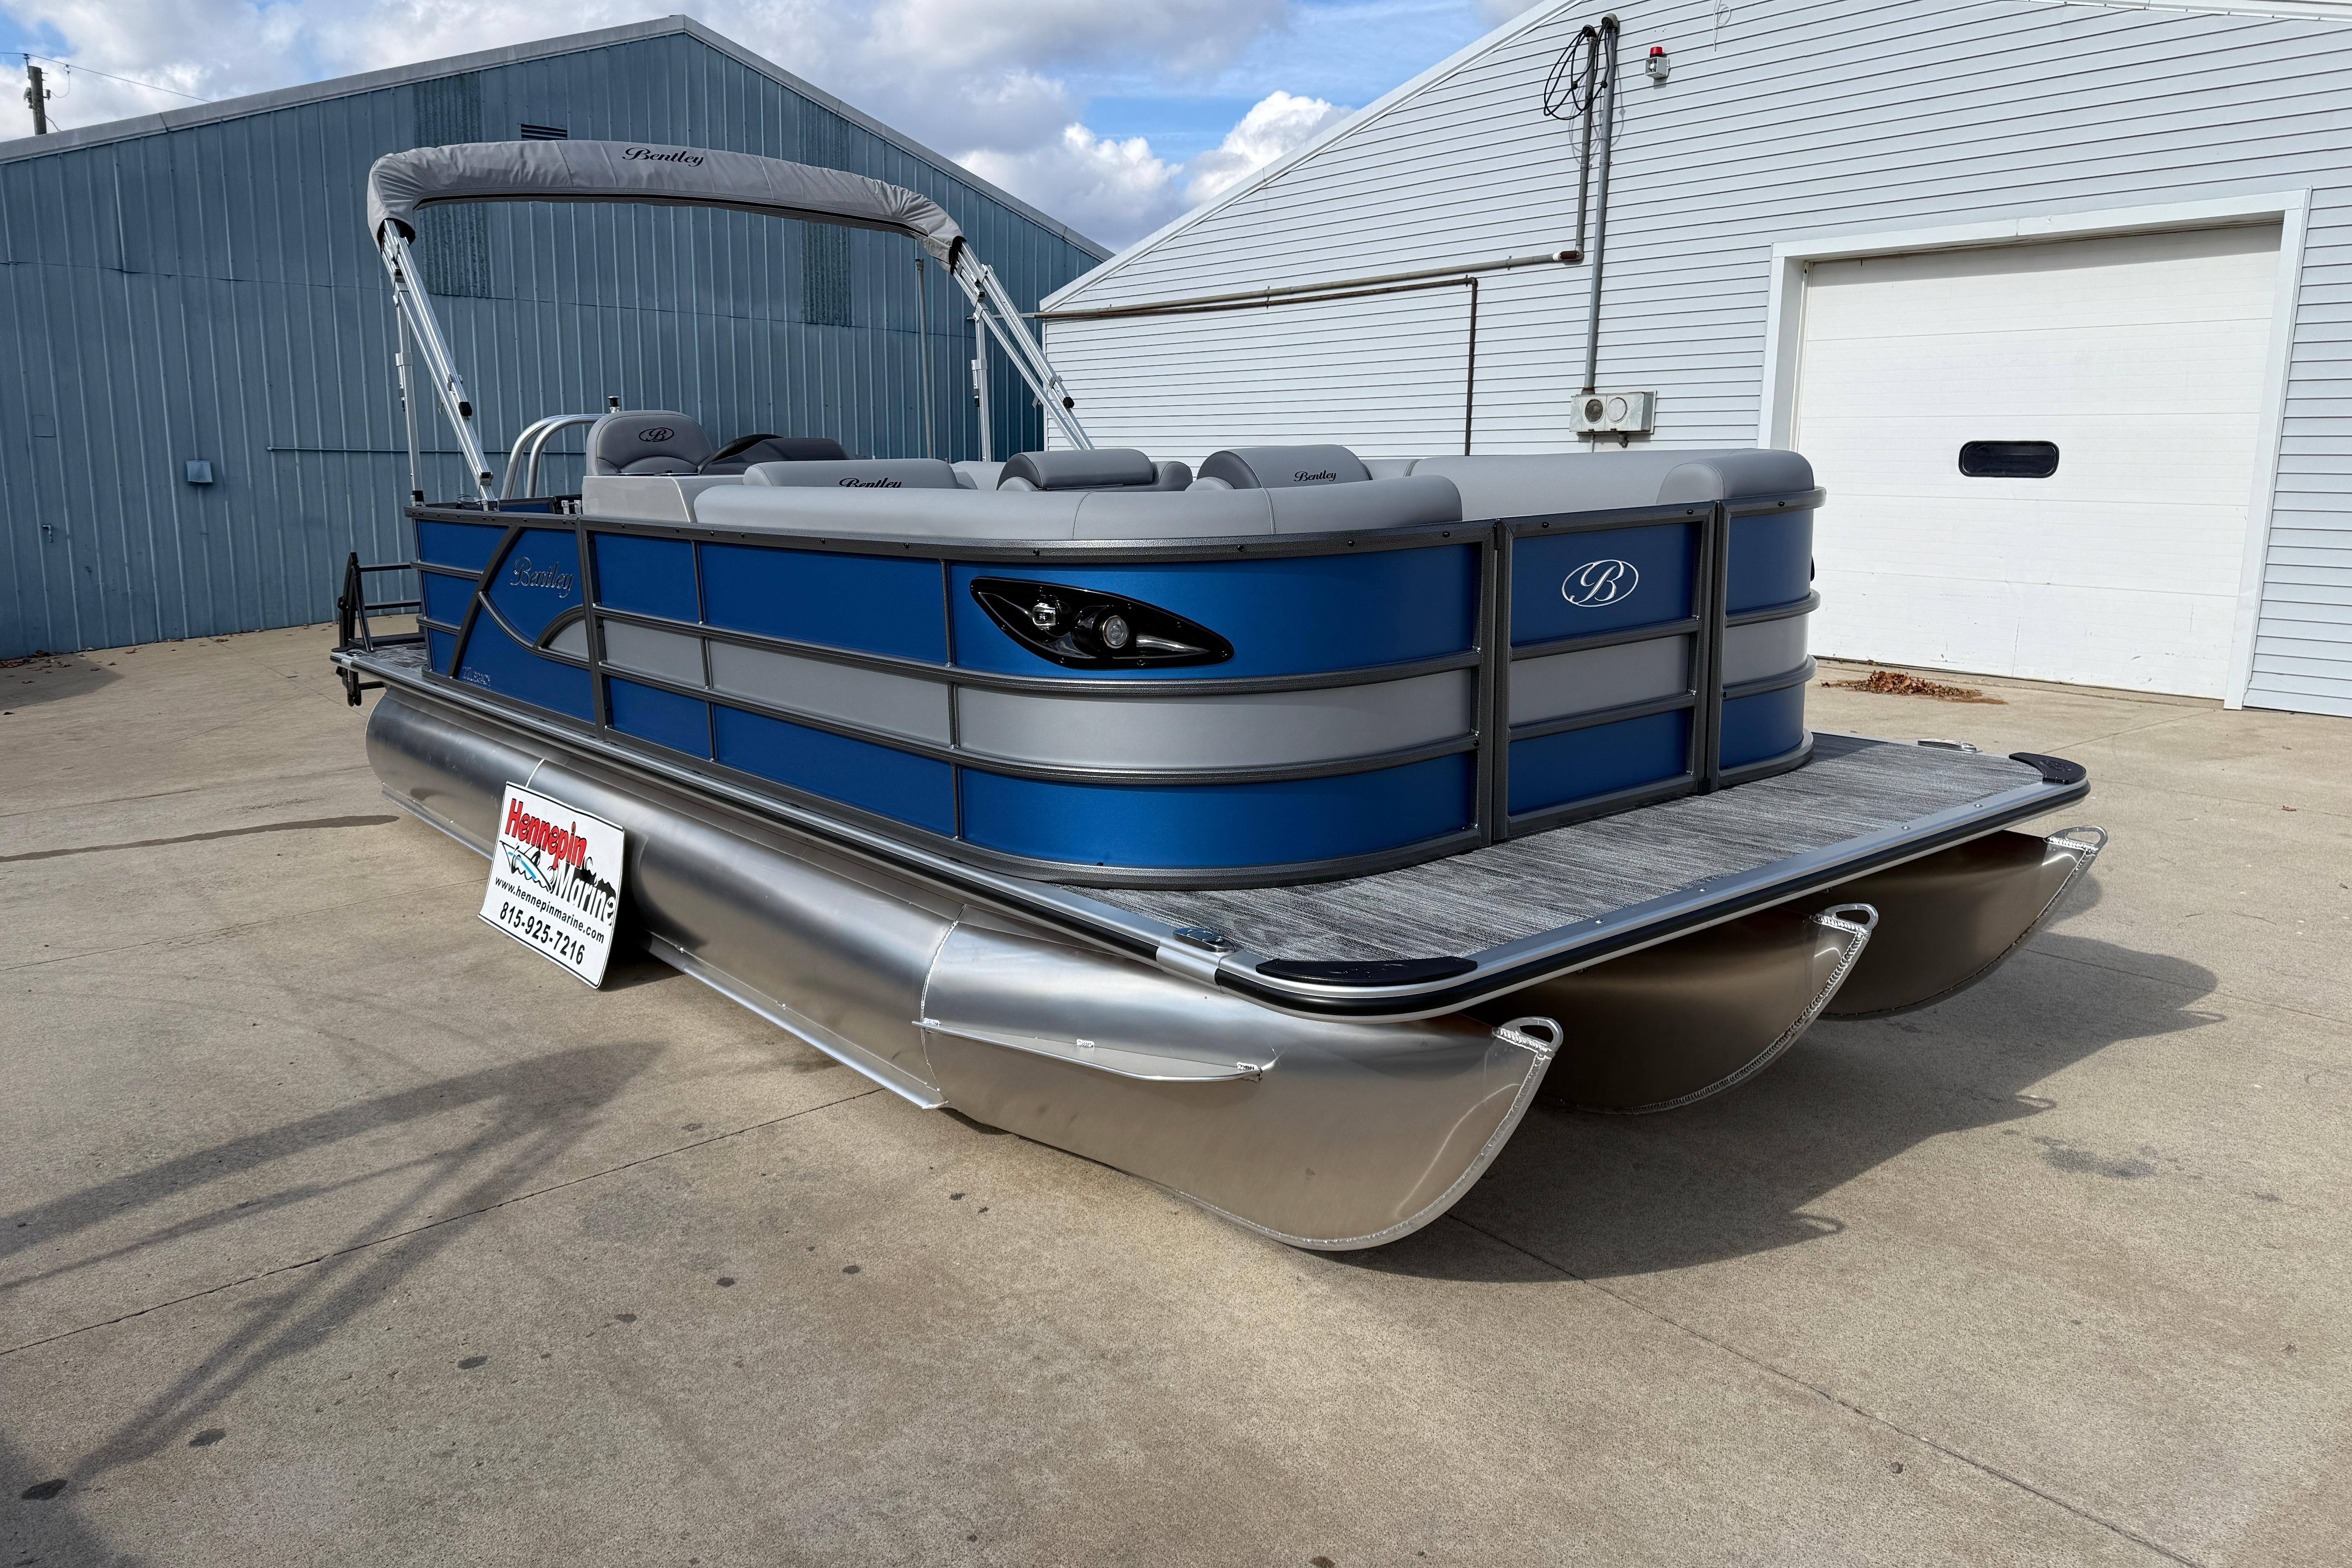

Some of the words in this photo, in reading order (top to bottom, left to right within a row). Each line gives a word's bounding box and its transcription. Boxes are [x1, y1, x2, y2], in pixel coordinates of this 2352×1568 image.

[622, 147, 704, 167] Bentley
[1294, 470, 1336, 481] Bentley
[510, 556, 574, 598] Bentley
[1568, 559, 1625, 606] B
[505, 798, 587, 870] Hennepin
[495, 877, 604, 944] www.hennepinmarine.com
[555, 862, 616, 926] Marine
[500, 902, 585, 965] 815-925-7216
